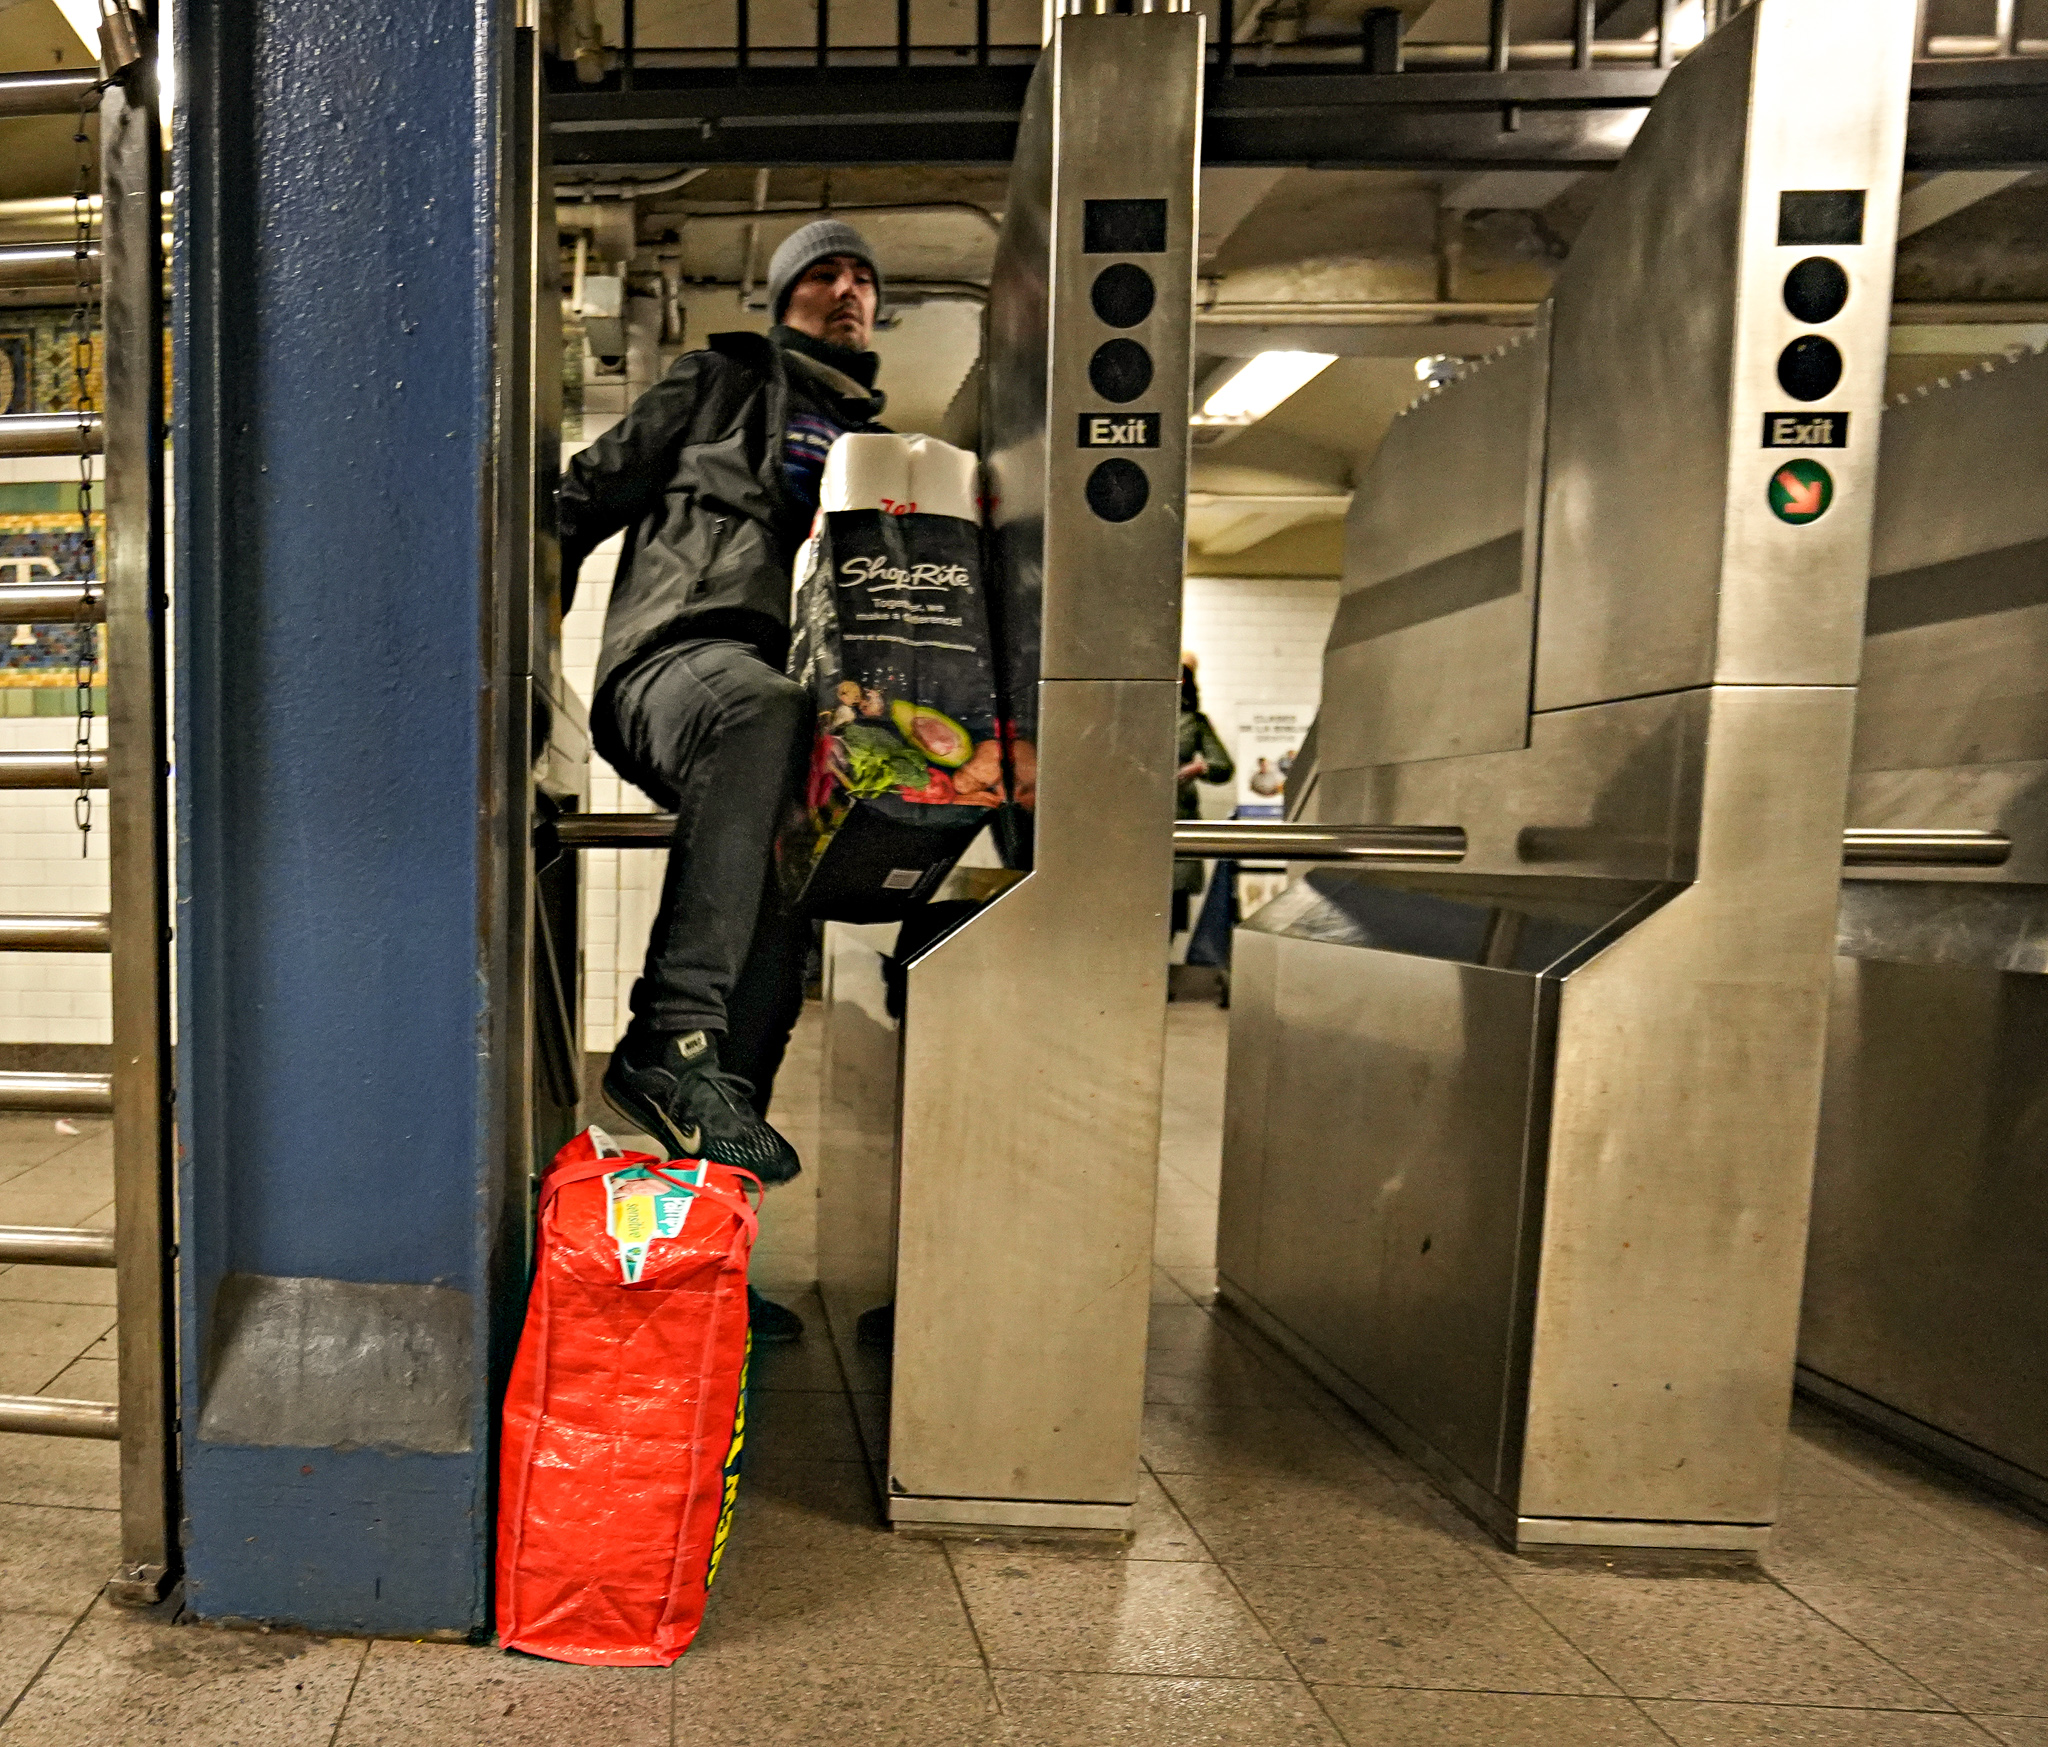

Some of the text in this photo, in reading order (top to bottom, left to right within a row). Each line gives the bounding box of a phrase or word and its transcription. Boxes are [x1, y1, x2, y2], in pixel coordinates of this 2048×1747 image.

[1089, 419, 1147, 444] Exit
[1772, 418, 1834, 444] Exit
[839, 555, 970, 590] ShopRite
[626, 1203, 644, 1238] sensitive
